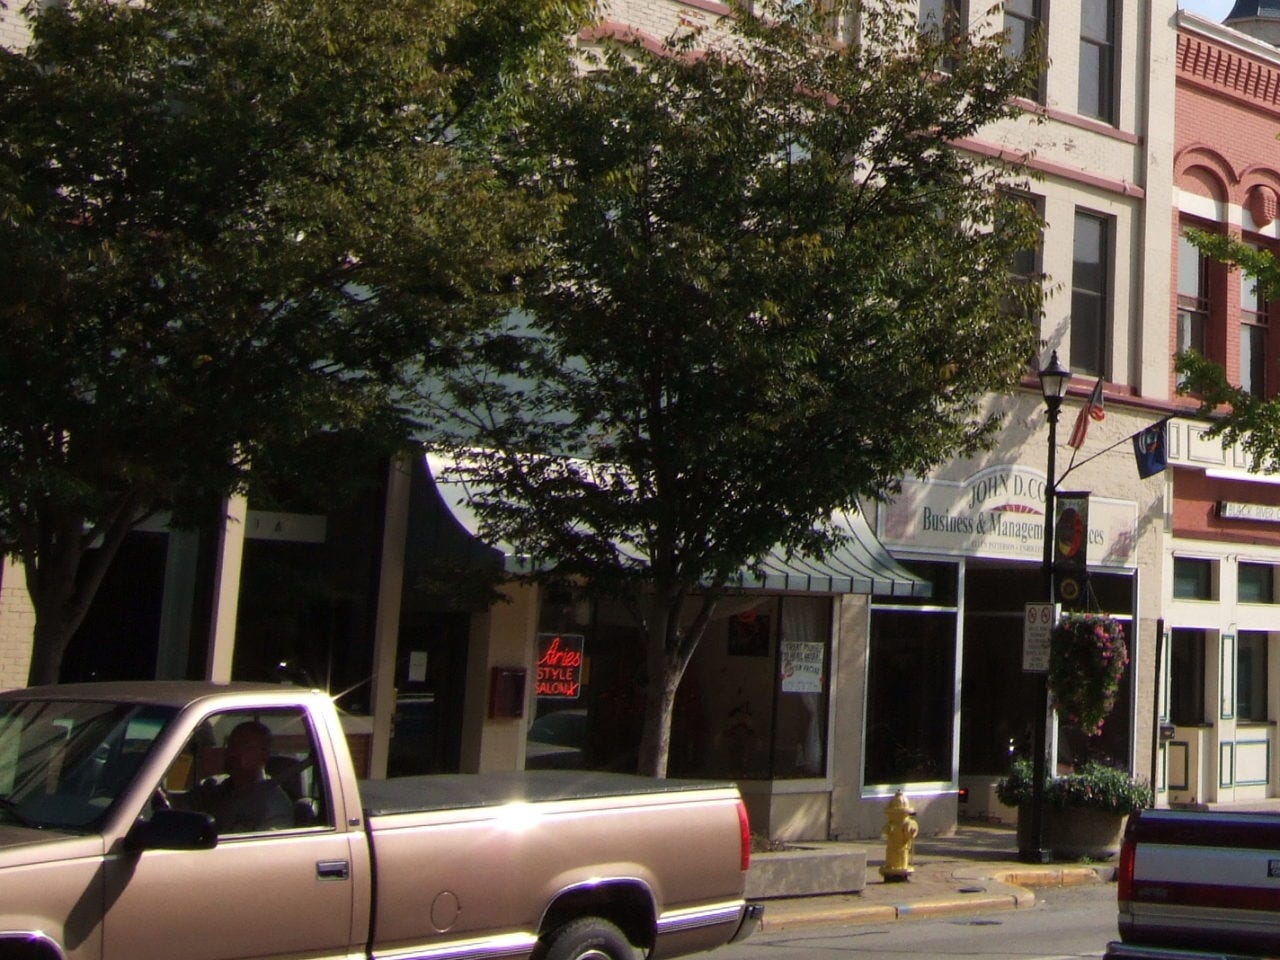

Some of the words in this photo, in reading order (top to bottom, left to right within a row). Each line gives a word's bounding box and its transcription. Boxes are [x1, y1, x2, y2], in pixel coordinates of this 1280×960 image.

[968, 474, 1010, 509] JOHN
[923, 506, 974, 533] Business
[976, 512, 986, 535] &
[990, 513, 1045, 543] Managem
[536, 637, 581, 667] Aries
[536, 667, 573, 680] STYLE
